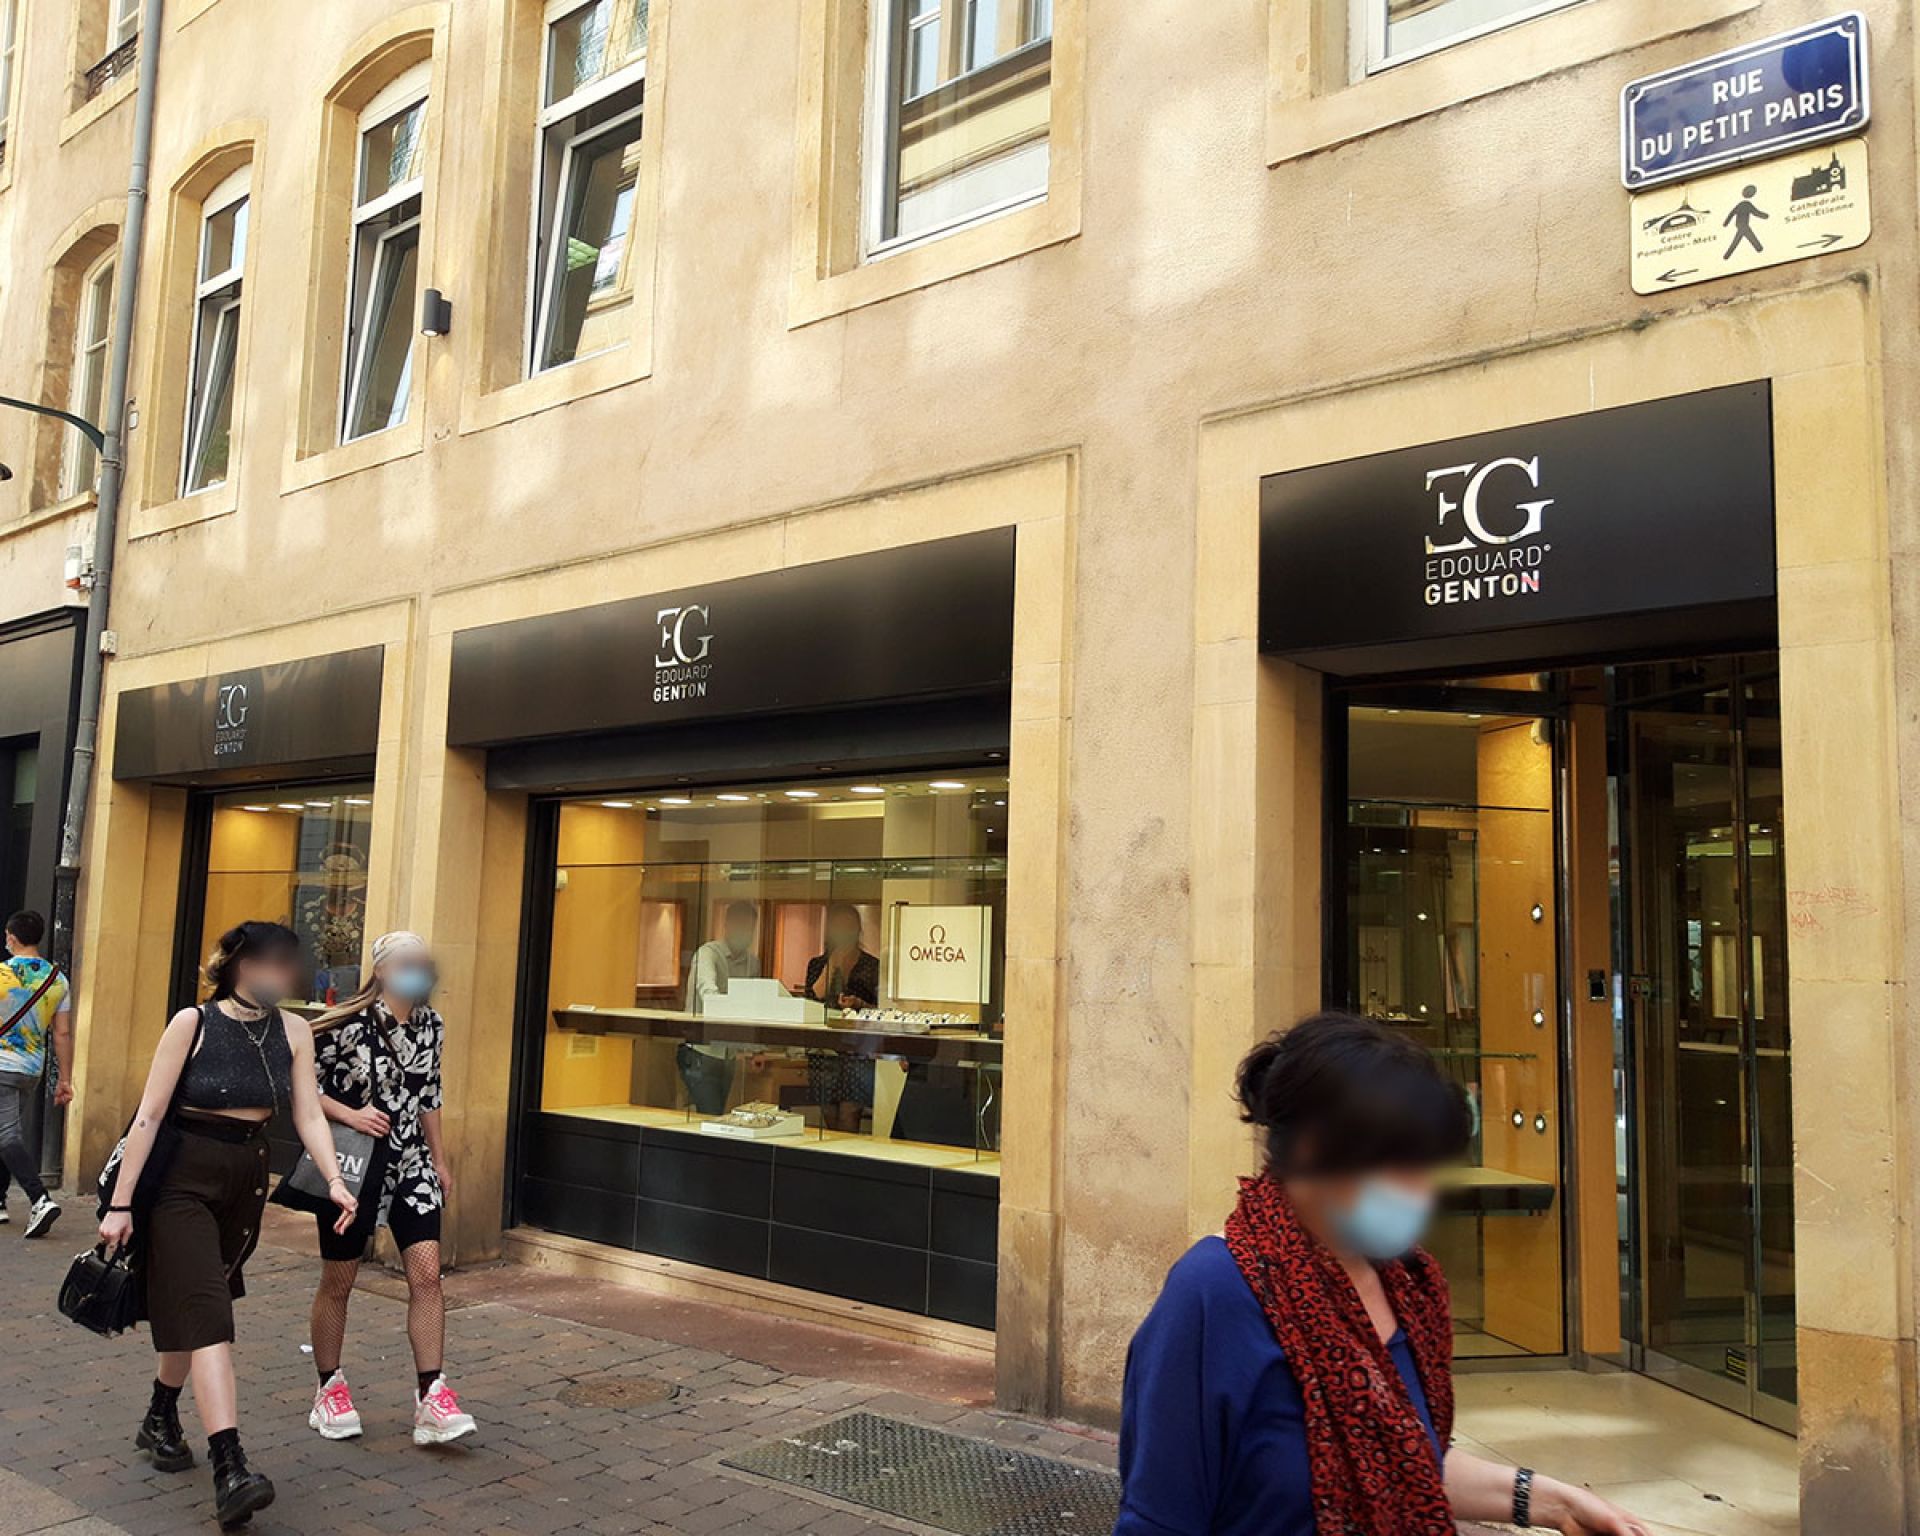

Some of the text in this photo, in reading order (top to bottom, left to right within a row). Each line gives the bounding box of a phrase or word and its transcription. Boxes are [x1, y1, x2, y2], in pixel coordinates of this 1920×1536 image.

[1712, 68, 1764, 105] RUE
[1641, 84, 1844, 161] DU PETIT PARIS
[1424, 455, 1555, 555] EG
[1424, 570, 1540, 605] GENTON
[655, 604, 715, 668] EG
[216, 684, 248, 729] EG
[653, 682, 706, 702] GENTON
[909, 945, 966, 962] OMEGA
